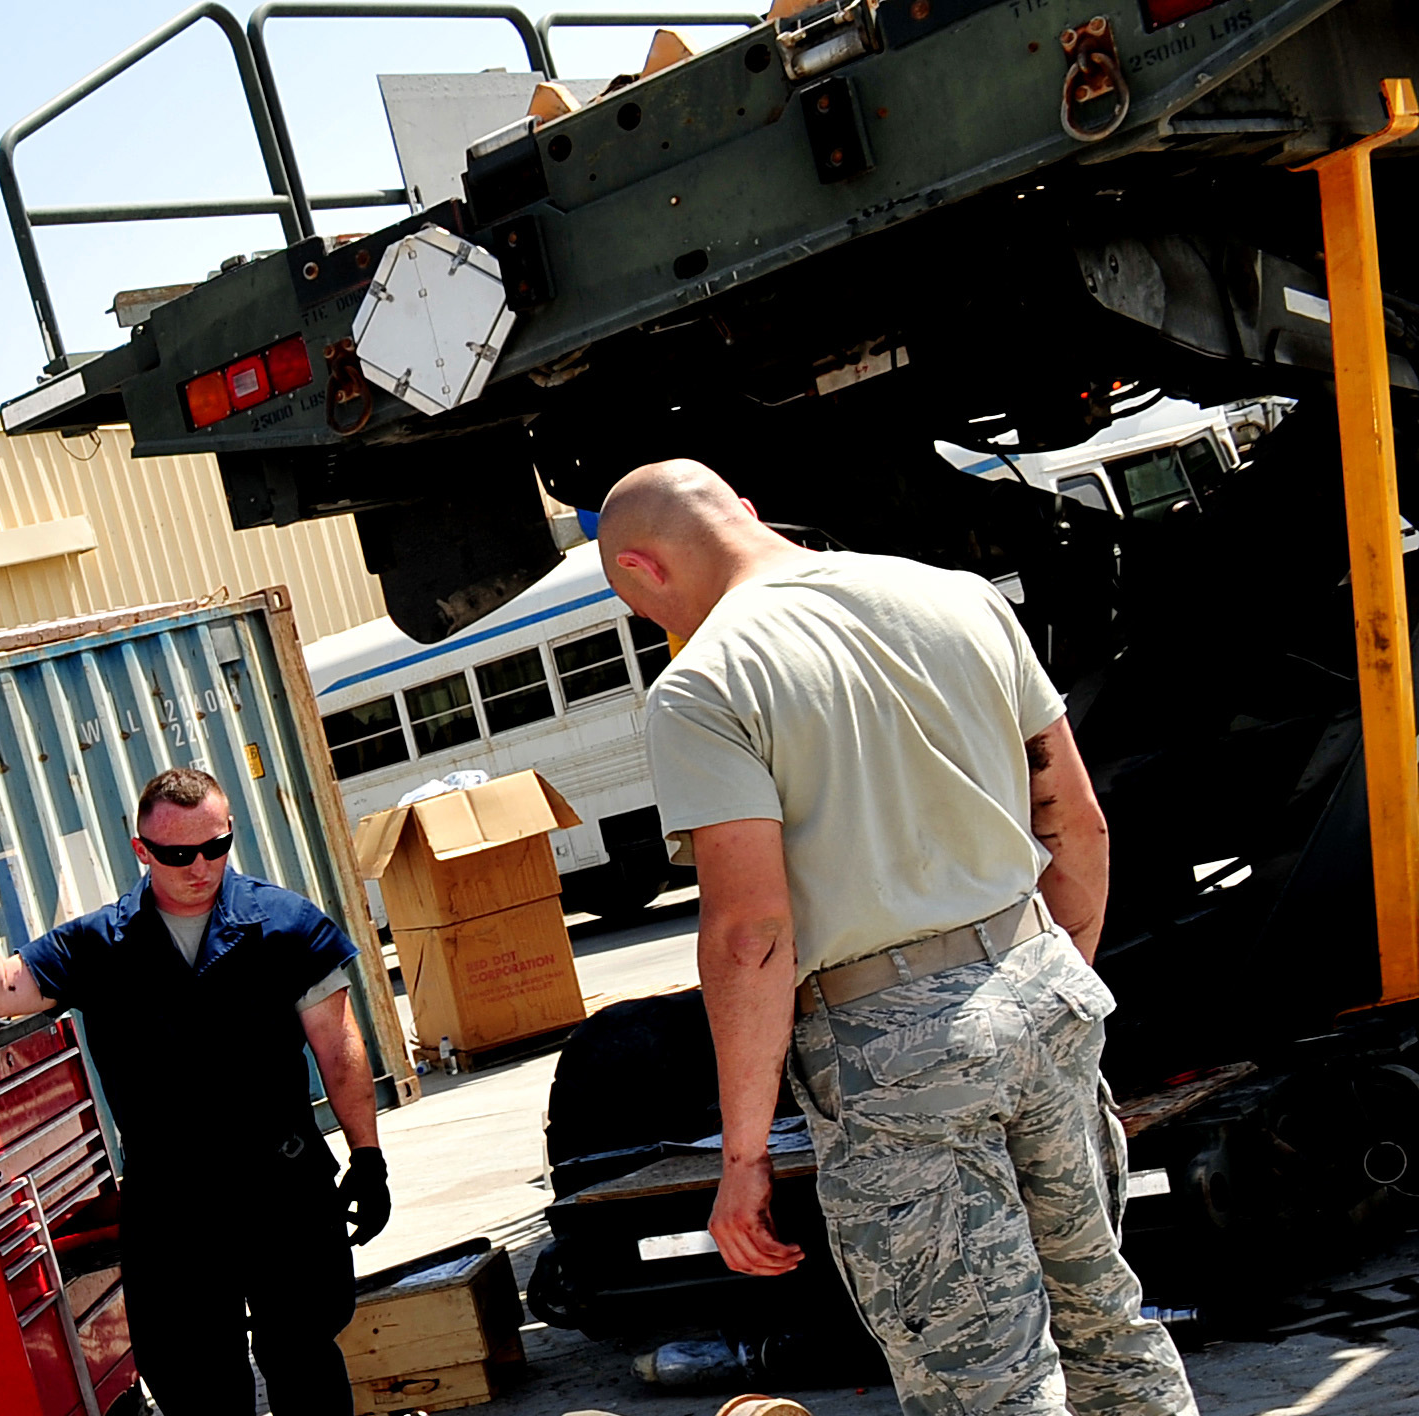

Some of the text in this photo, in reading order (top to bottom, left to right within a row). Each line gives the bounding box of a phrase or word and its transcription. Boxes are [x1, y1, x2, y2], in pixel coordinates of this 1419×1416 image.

[1129, 9, 1254, 73] 25000 LBS
[252, 406, 293, 432] 25000
[466, 950, 516, 973] RED DOT
[469, 954, 556, 985] CORPORATION
